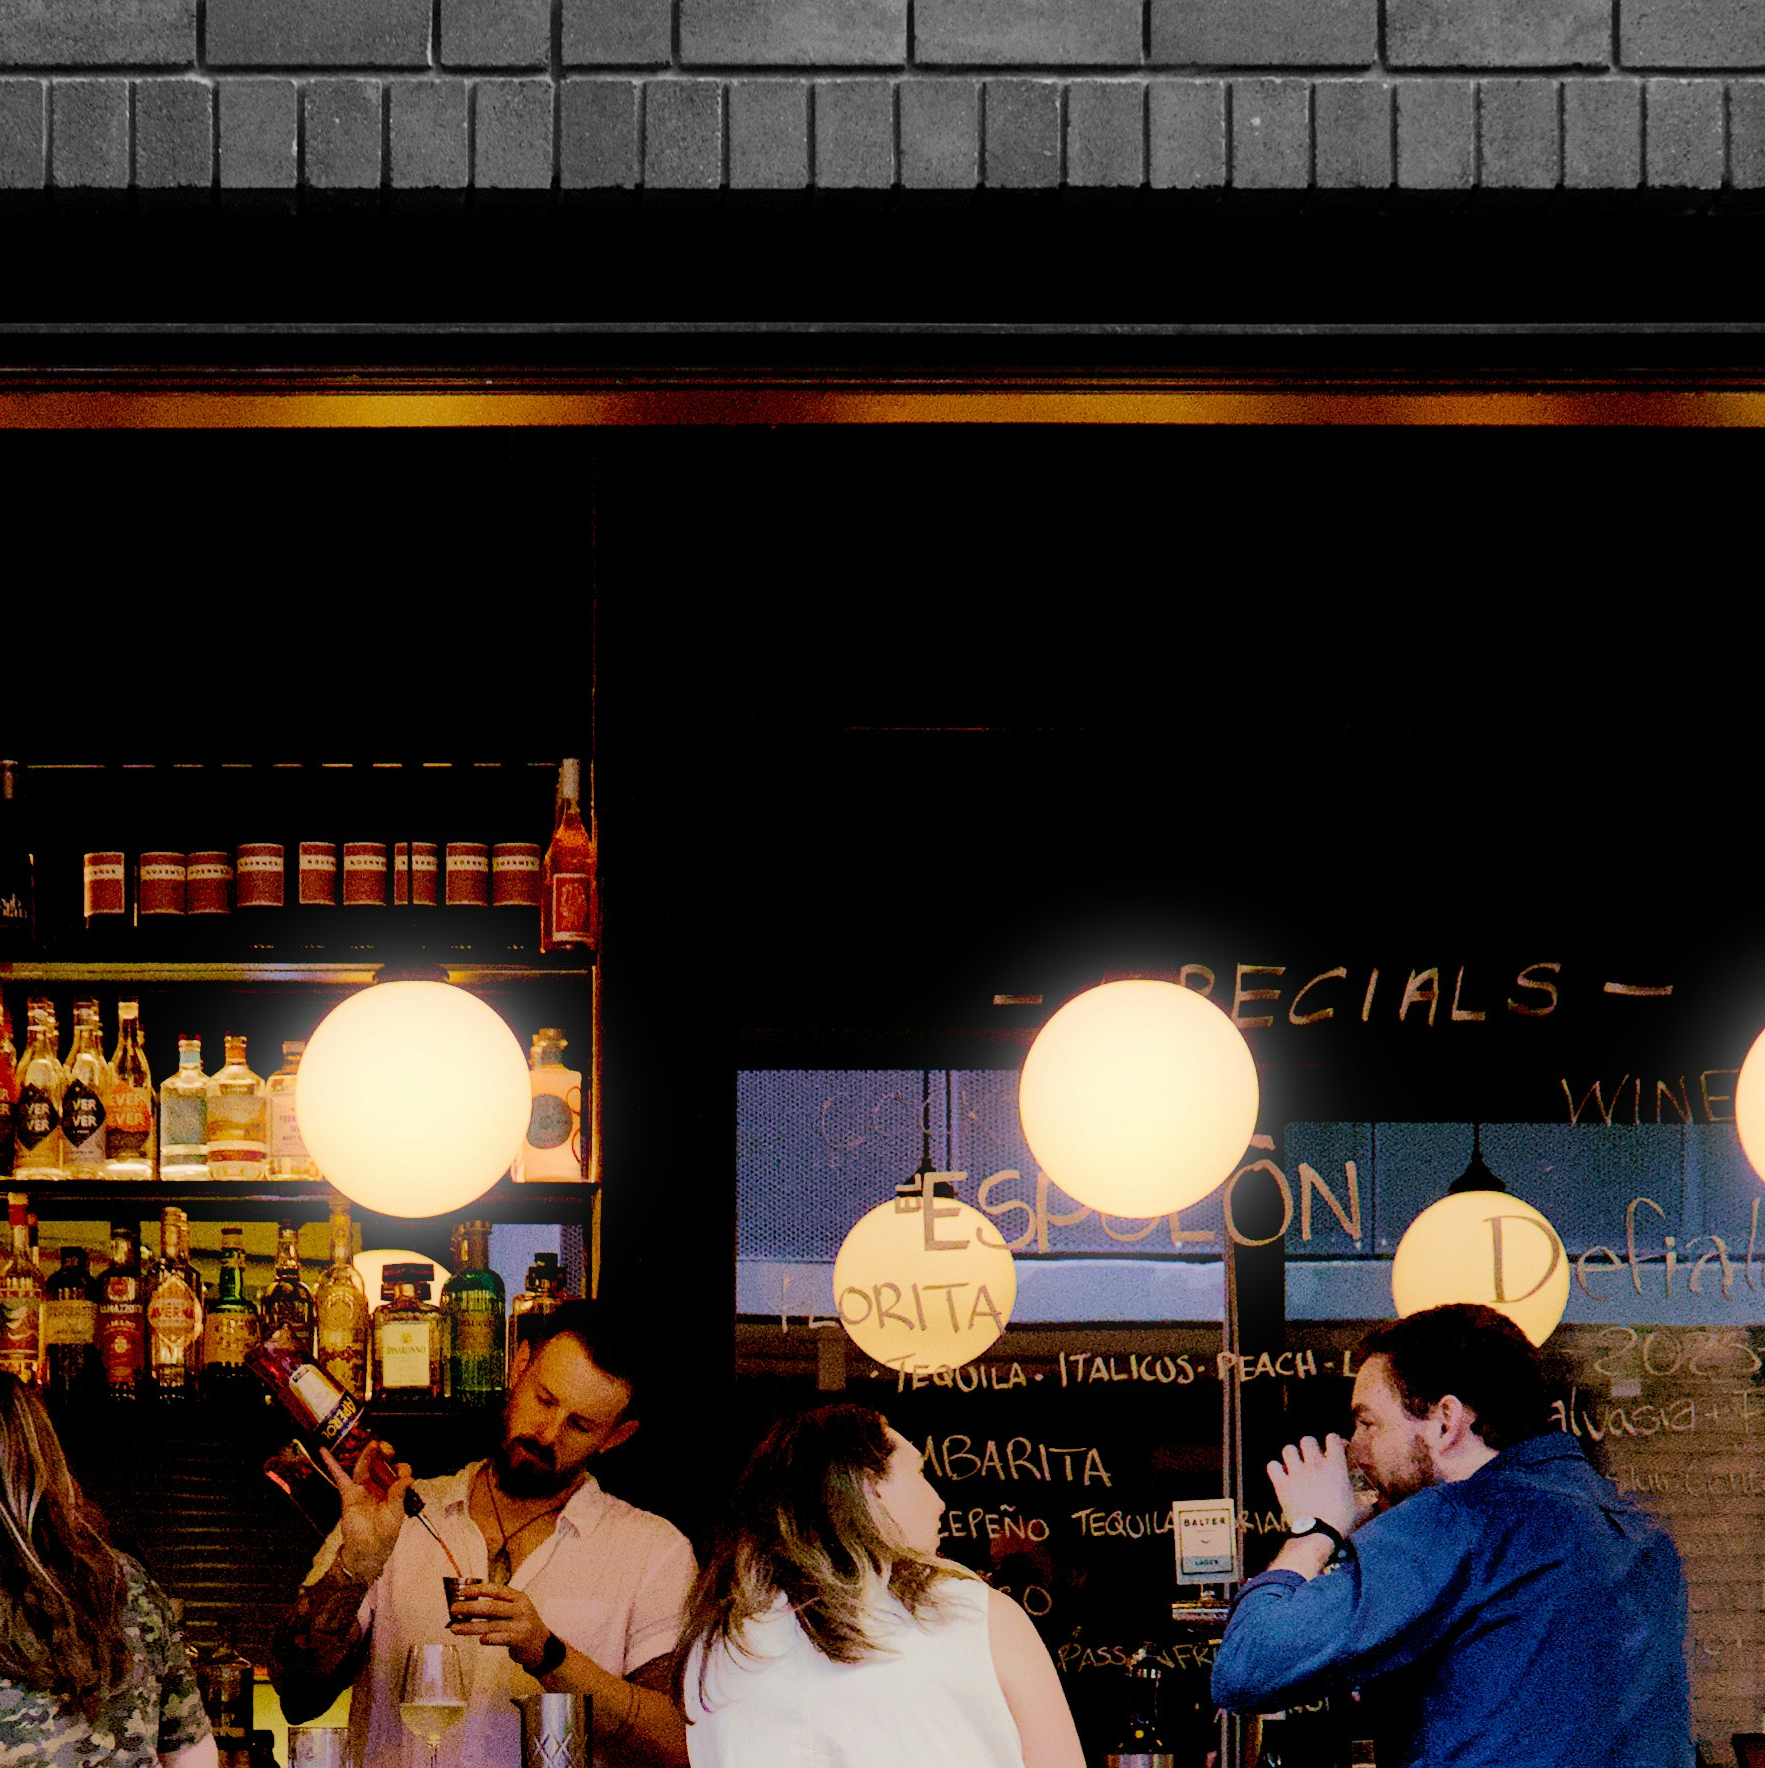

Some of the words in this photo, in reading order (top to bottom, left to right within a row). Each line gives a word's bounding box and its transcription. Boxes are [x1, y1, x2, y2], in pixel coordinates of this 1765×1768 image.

[1175, 962, 1561, 1029] PECIALS
[886, 1353, 1027, 1393] TEQUILA
[1216, 1349, 1318, 1382] PEACH
[320, 1396, 357, 1440] APEROL
[1547, 1386, 1696, 1441] alvasia
[912, 1434, 1114, 1489] MBARITA
[1071, 1508, 1175, 1540] TEQUILA
[1183, 1516, 1226, 1527] BALTER
